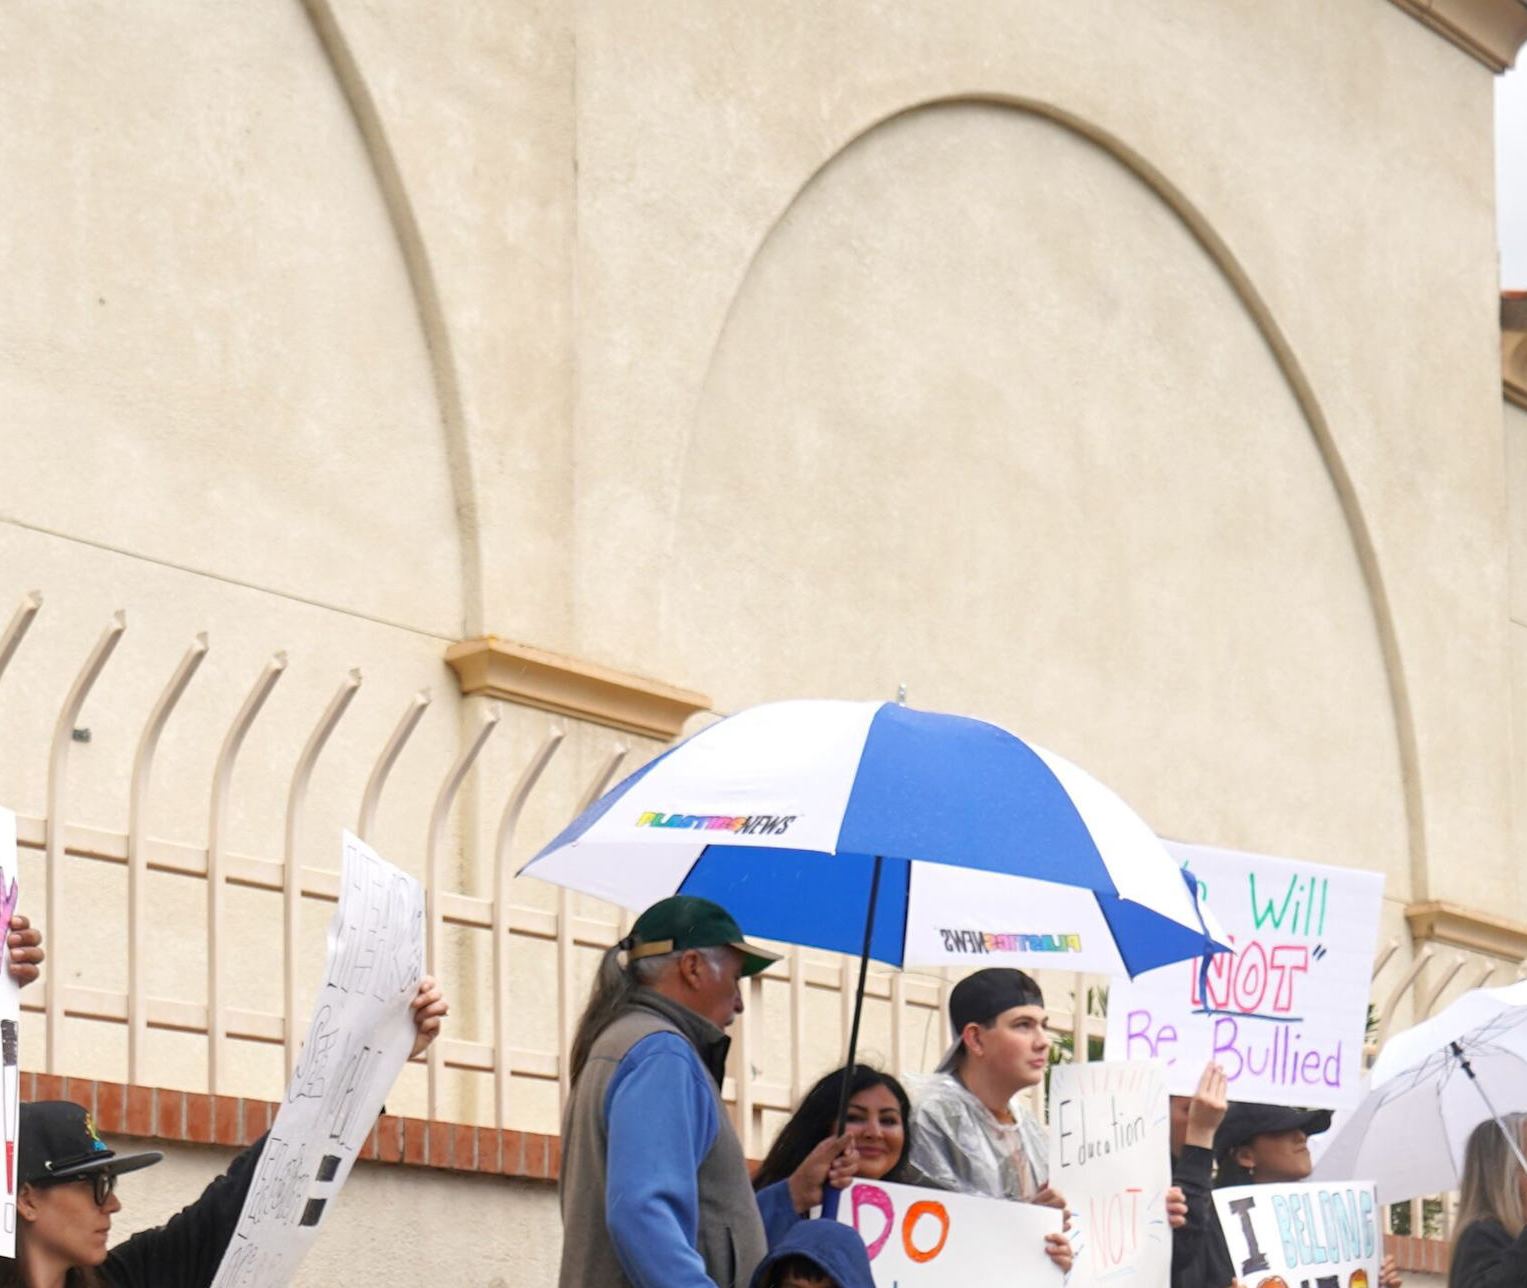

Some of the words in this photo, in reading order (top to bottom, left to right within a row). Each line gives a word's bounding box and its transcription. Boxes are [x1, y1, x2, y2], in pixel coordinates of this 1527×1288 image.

[1249, 871, 1329, 937] Will
[1212, 1015, 1342, 1088] Bullied
[1059, 1094, 1147, 1169] Education
[851, 1182, 951, 1264] DO
[1089, 1187, 1143, 1274] NOT
[1228, 1195, 1272, 1278] I
[1270, 1188, 1376, 1270] BELONG
